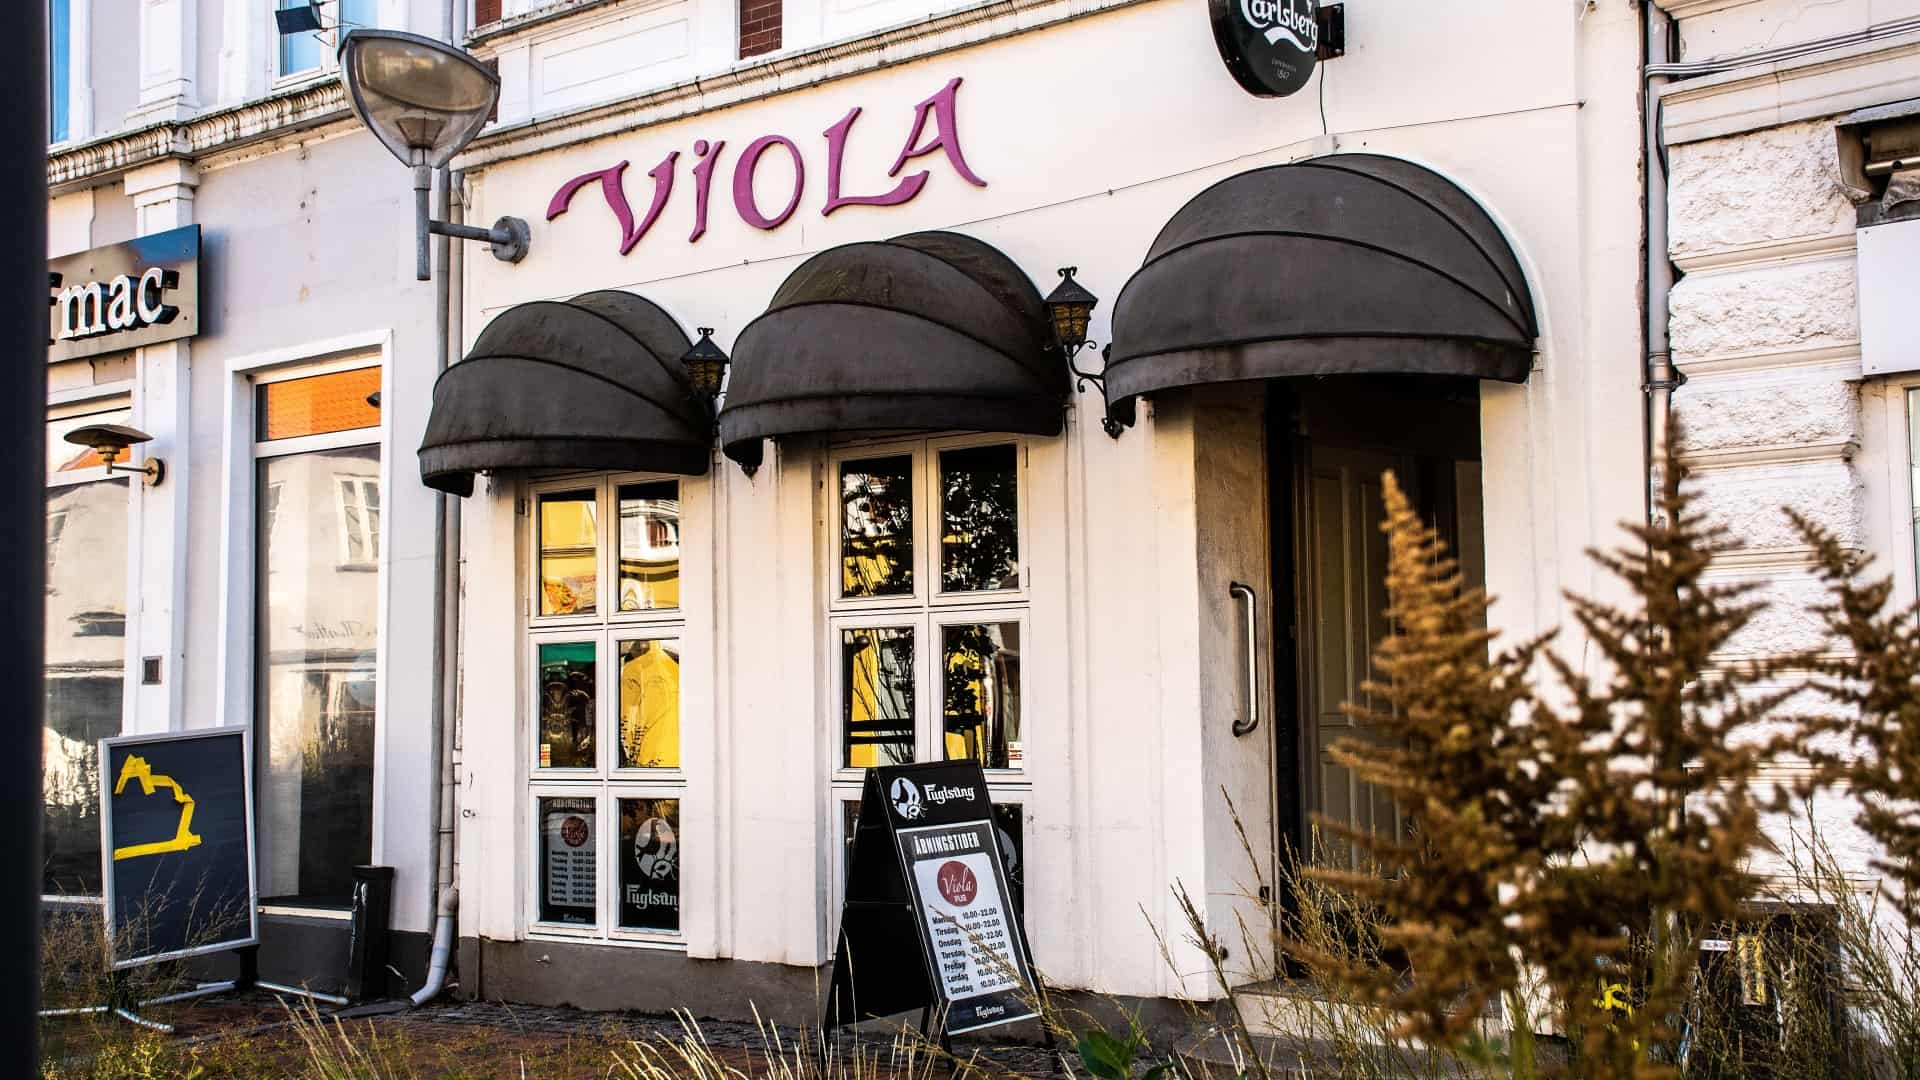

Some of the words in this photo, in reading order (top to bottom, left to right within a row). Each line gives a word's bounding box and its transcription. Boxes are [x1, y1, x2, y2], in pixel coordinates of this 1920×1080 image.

[1240, 0, 1318, 51] Carlsberg
[913, 831, 980, 855] ÅBNINGSTIDER
[942, 866, 973, 894] Viola
[626, 884, 679, 911] Fuglsan
